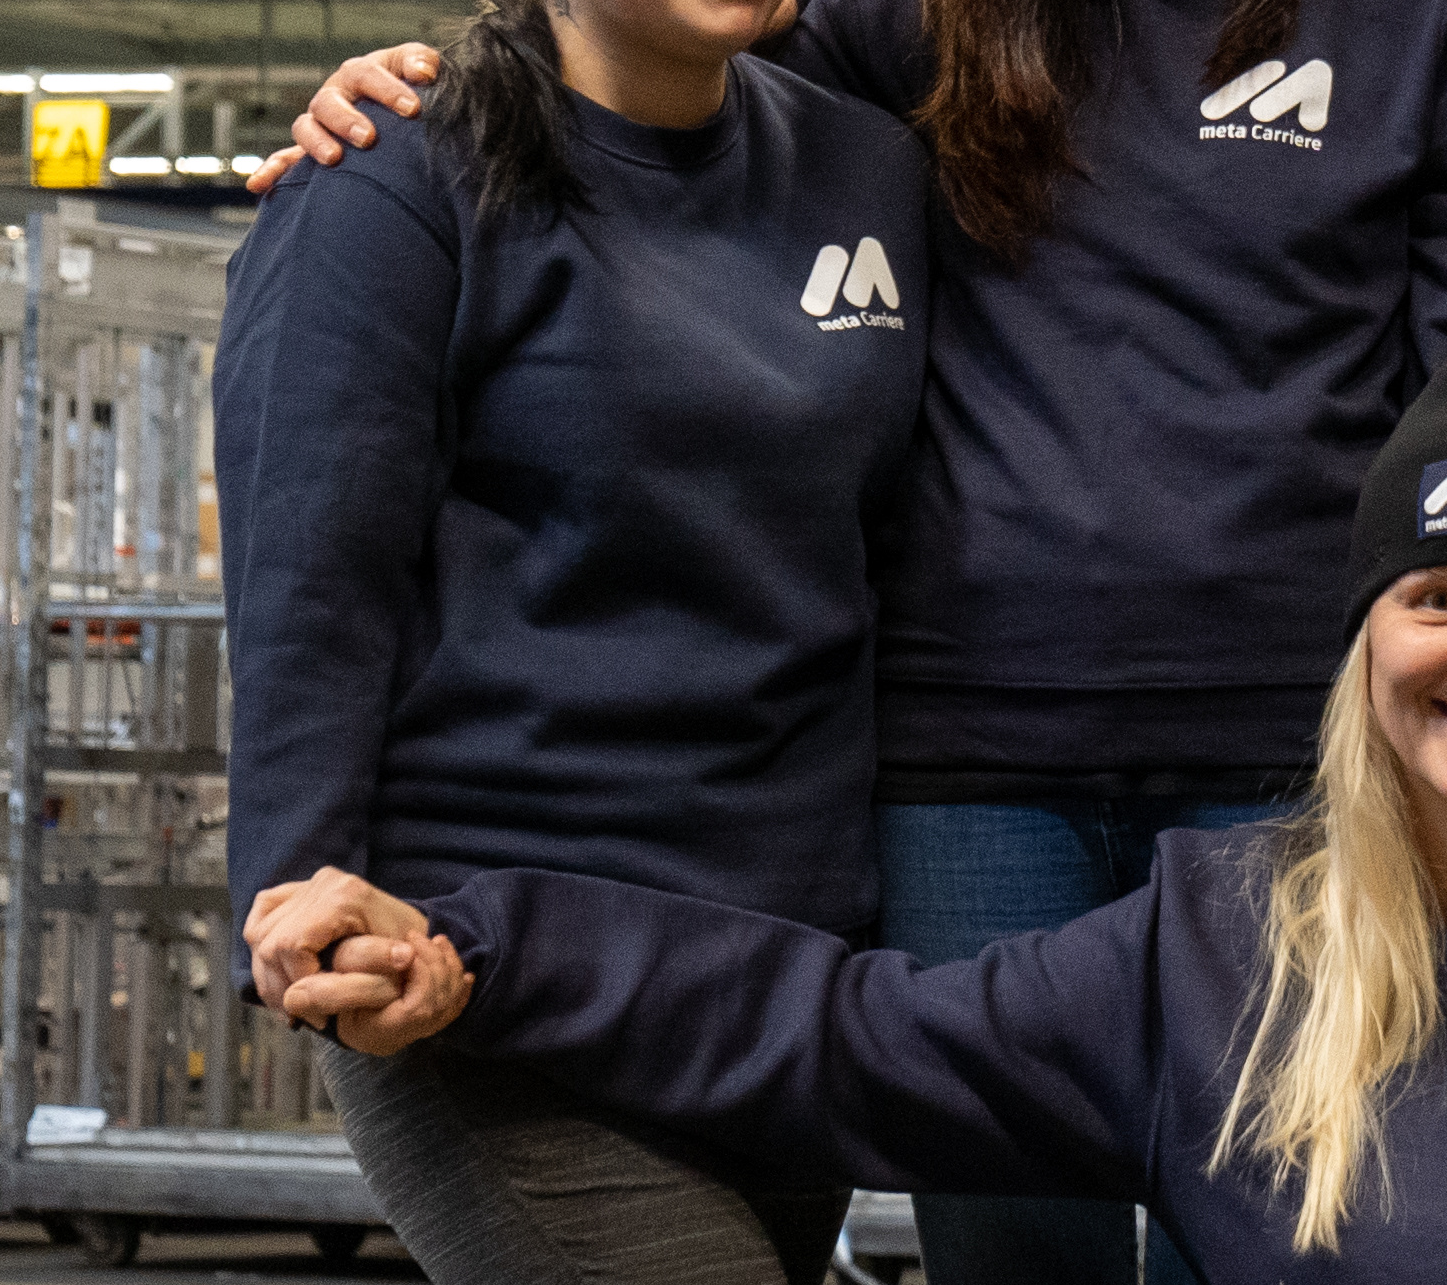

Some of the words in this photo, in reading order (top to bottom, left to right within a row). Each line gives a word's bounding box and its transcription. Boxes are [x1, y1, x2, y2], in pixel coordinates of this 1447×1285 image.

[1199, 123, 1247, 140] meta
[1251, 124, 1323, 151] Carriere
[817, 315, 861, 332] meta
